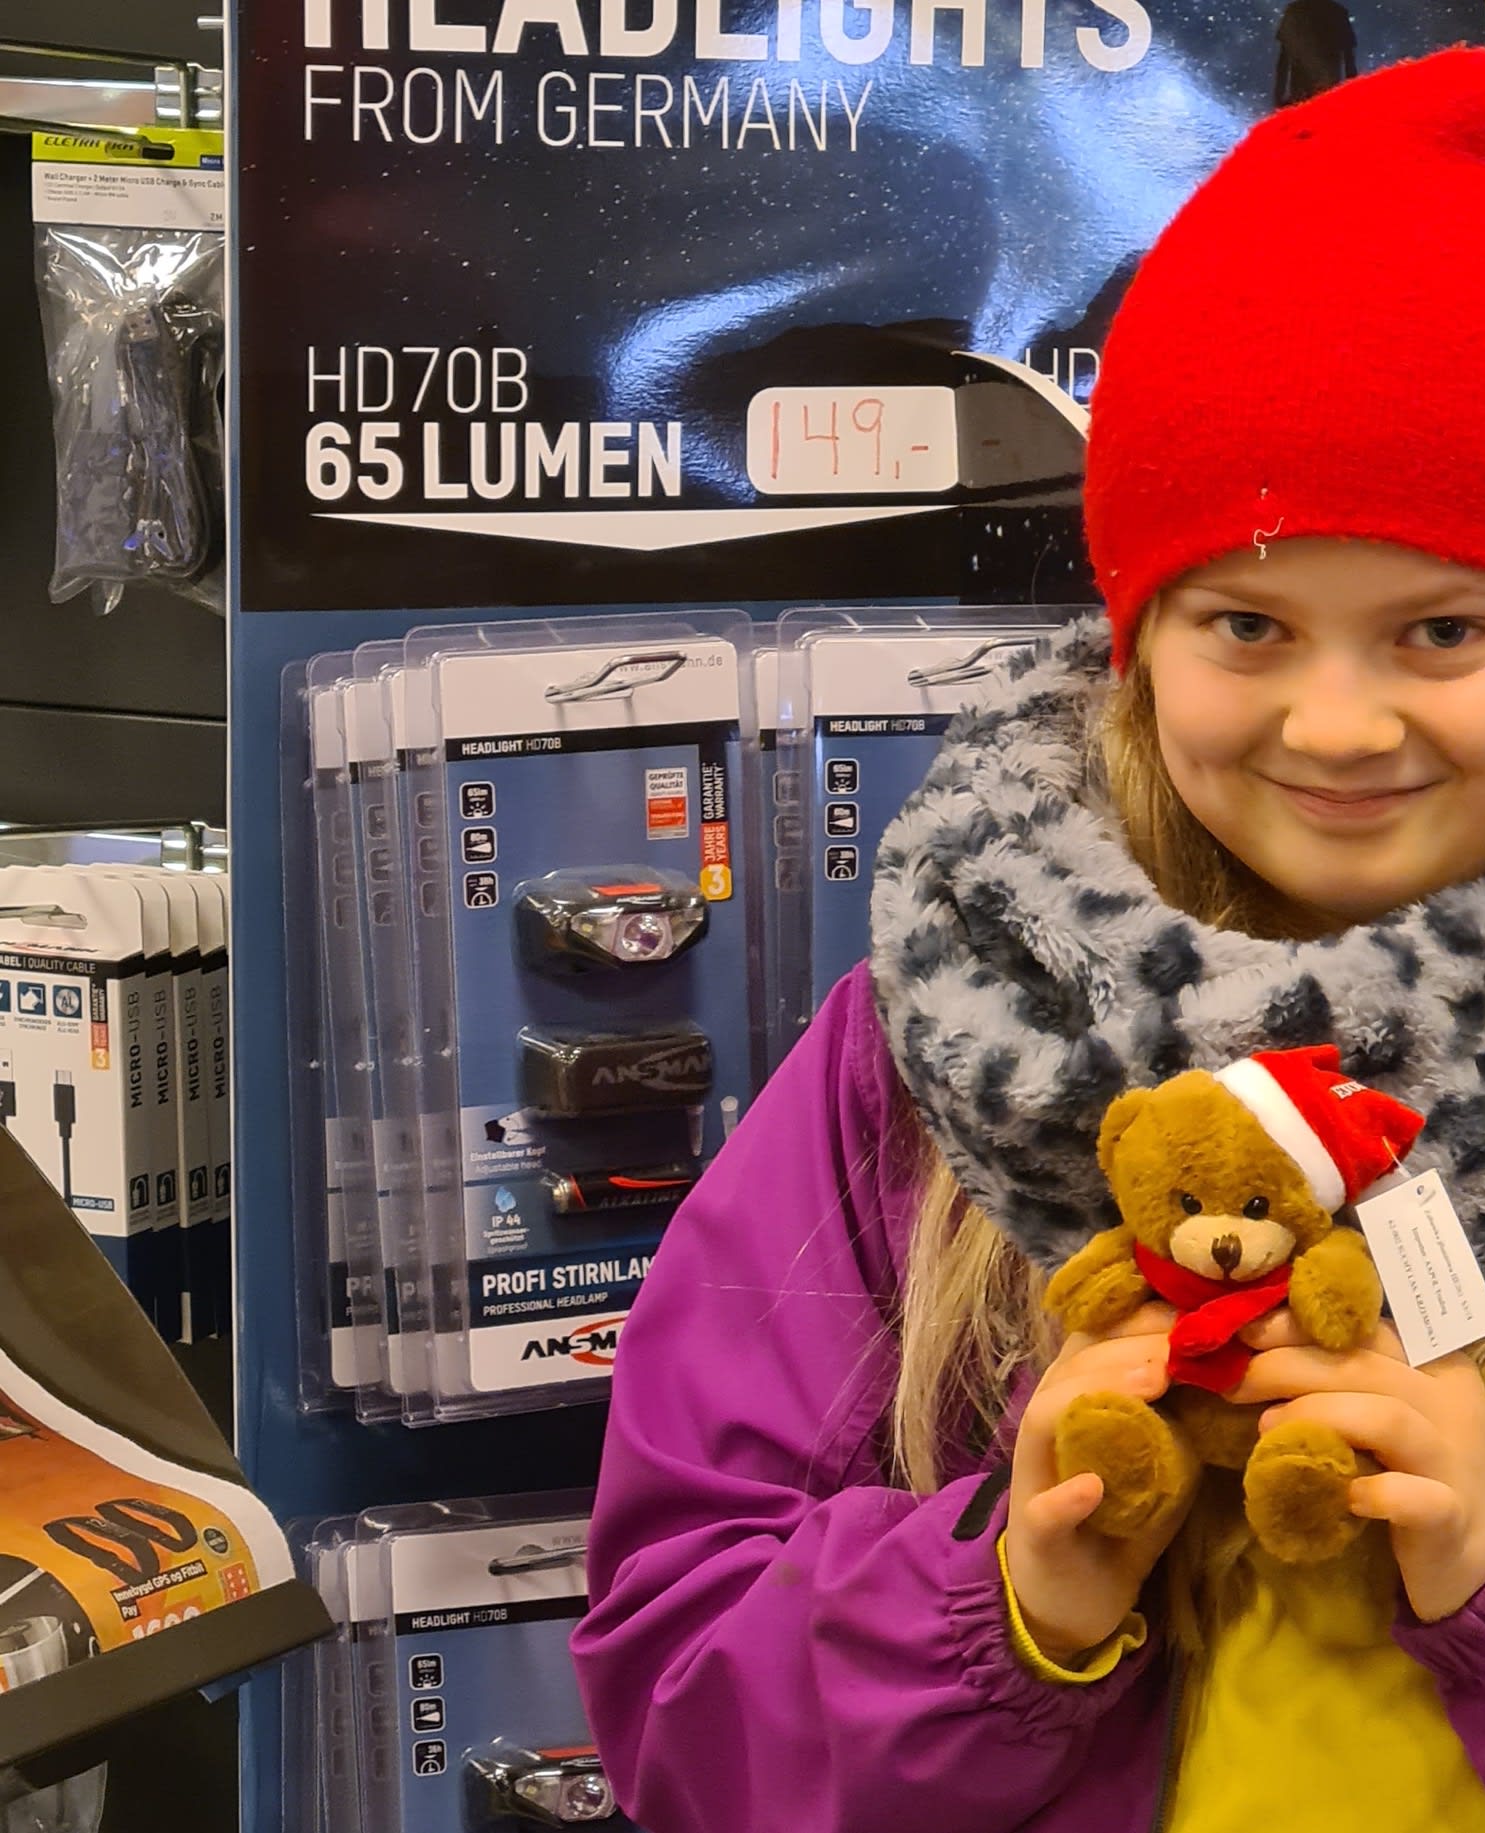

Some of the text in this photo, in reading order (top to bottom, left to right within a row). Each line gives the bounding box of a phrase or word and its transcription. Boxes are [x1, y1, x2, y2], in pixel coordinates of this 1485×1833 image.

[304, 65, 874, 152] FROM GERMANY
[306, 346, 530, 413] HD70B
[305, 421, 683, 501] 65 LUMEN
[829, 719, 925, 732] HEADLIGHT HD70B
[462, 737, 562, 756] HEADLIGHT HD70B
[704, 826, 715, 862] JAHRE
[715, 825, 727, 862] YEARS
[707, 865, 726, 896] 3
[27, 957, 64, 971] QUALITY
[66, 961, 96, 974] CABLE
[127, 991, 144, 1109] MICRO-USB
[154, 990, 170, 1105] MICRO-USB
[184, 987, 200, 1101] MICRO-USB
[492, 1213, 521, 1229] IP 44
[482, 1269, 546, 1298] PROFI
[483, 1291, 608, 1317] PROFESSIONAL HEADLAMP
[152, 1574, 171, 1588] GPS
[170, 1571, 183, 1582] og
[180, 1562, 205, 1579] Fitbit
[121, 1605, 138, 1619] Pay
[412, 1608, 508, 1628] HEADLIGHT HD70B
